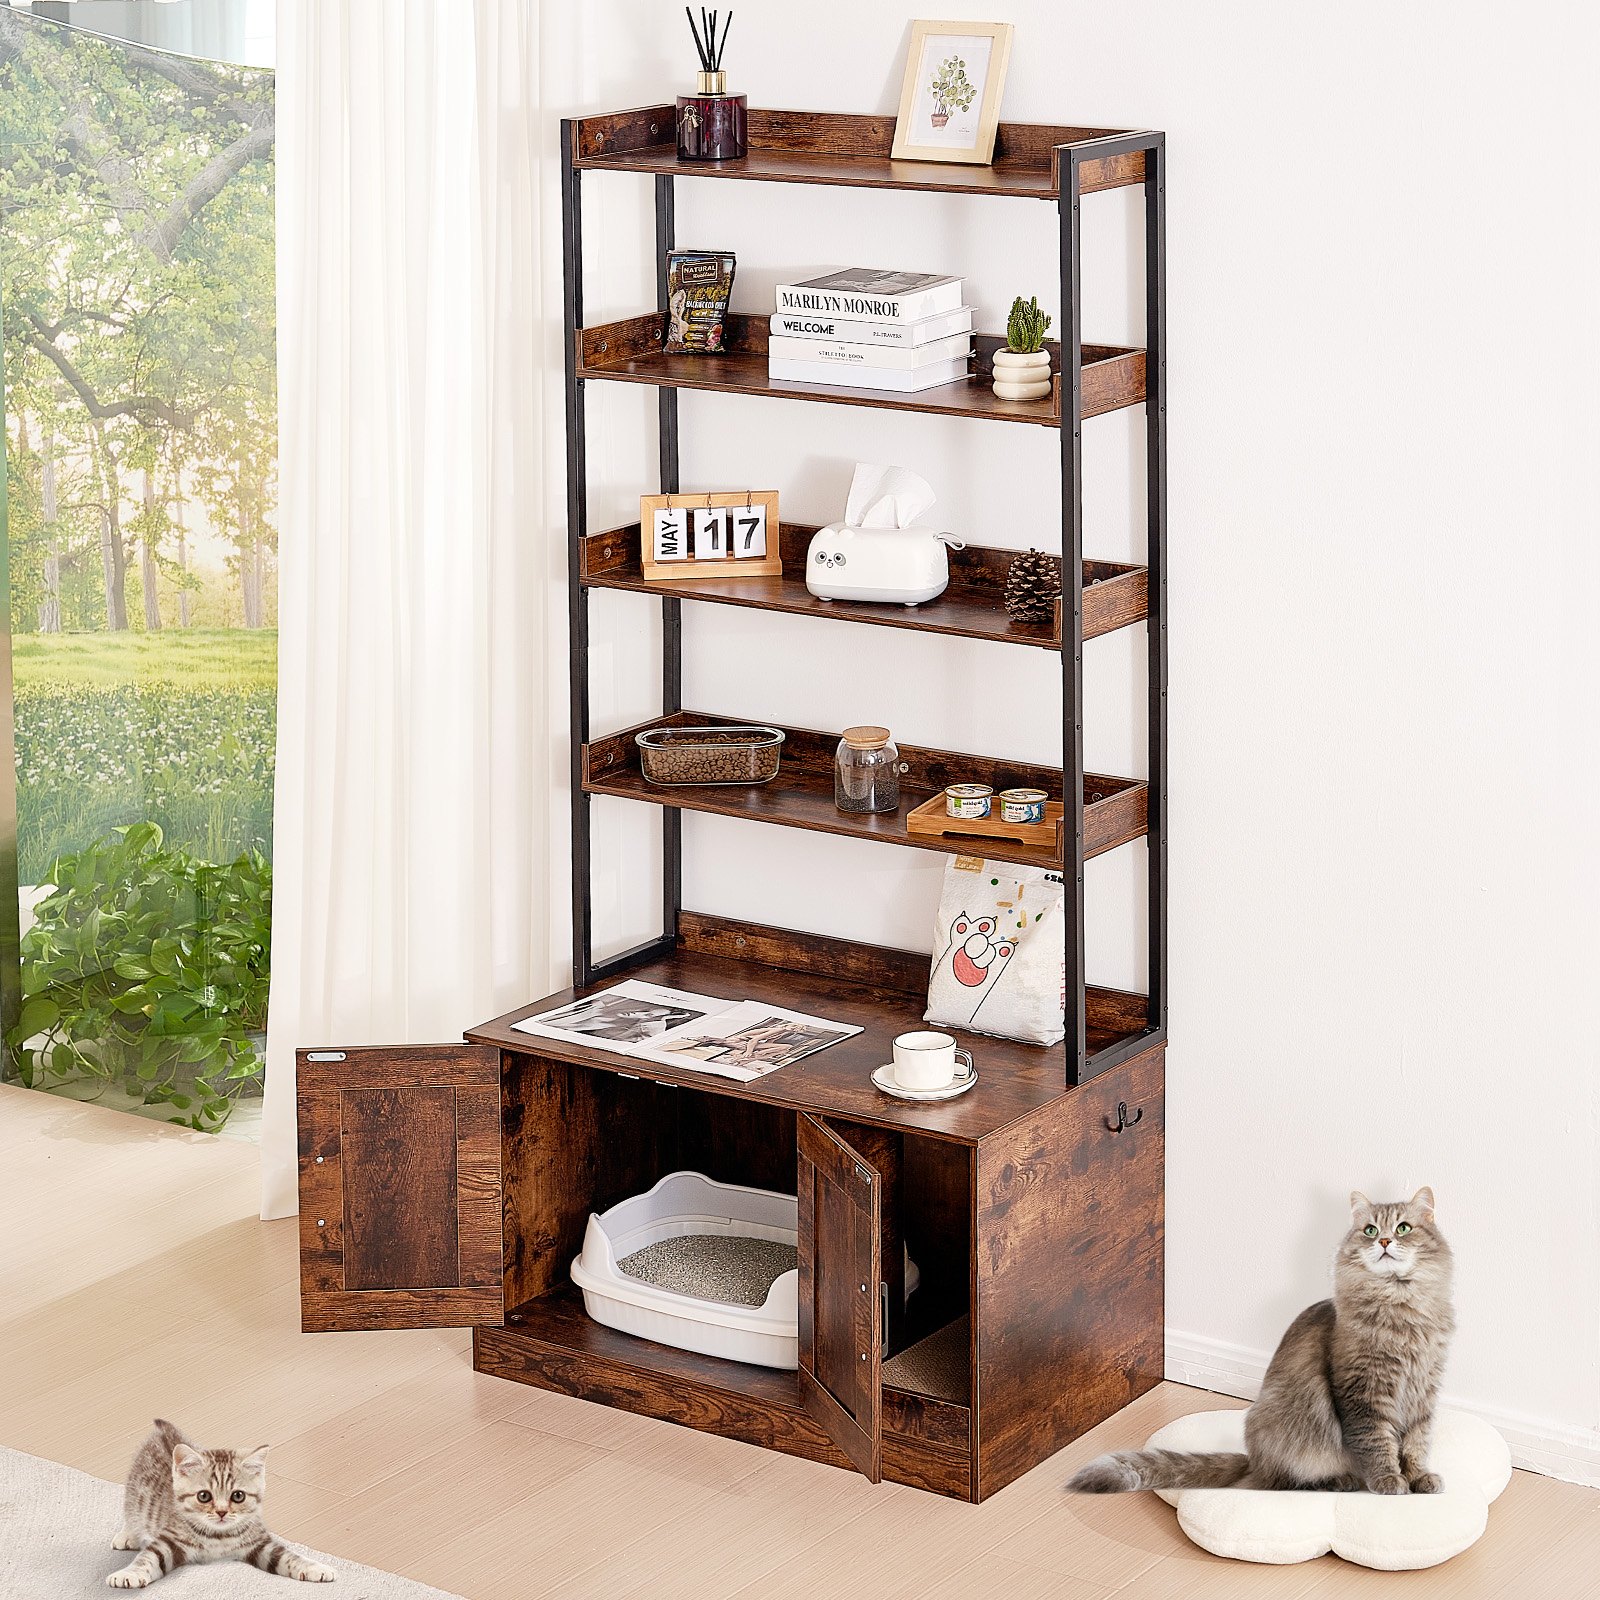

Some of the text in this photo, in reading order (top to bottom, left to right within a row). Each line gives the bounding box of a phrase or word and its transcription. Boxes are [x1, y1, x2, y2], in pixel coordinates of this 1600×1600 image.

[683, 265, 716, 273] NATURAL
[782, 292, 900, 317] MARILYN MONROE
[782, 320, 835, 335] WELCOME
[661, 520, 679, 555] MAY
